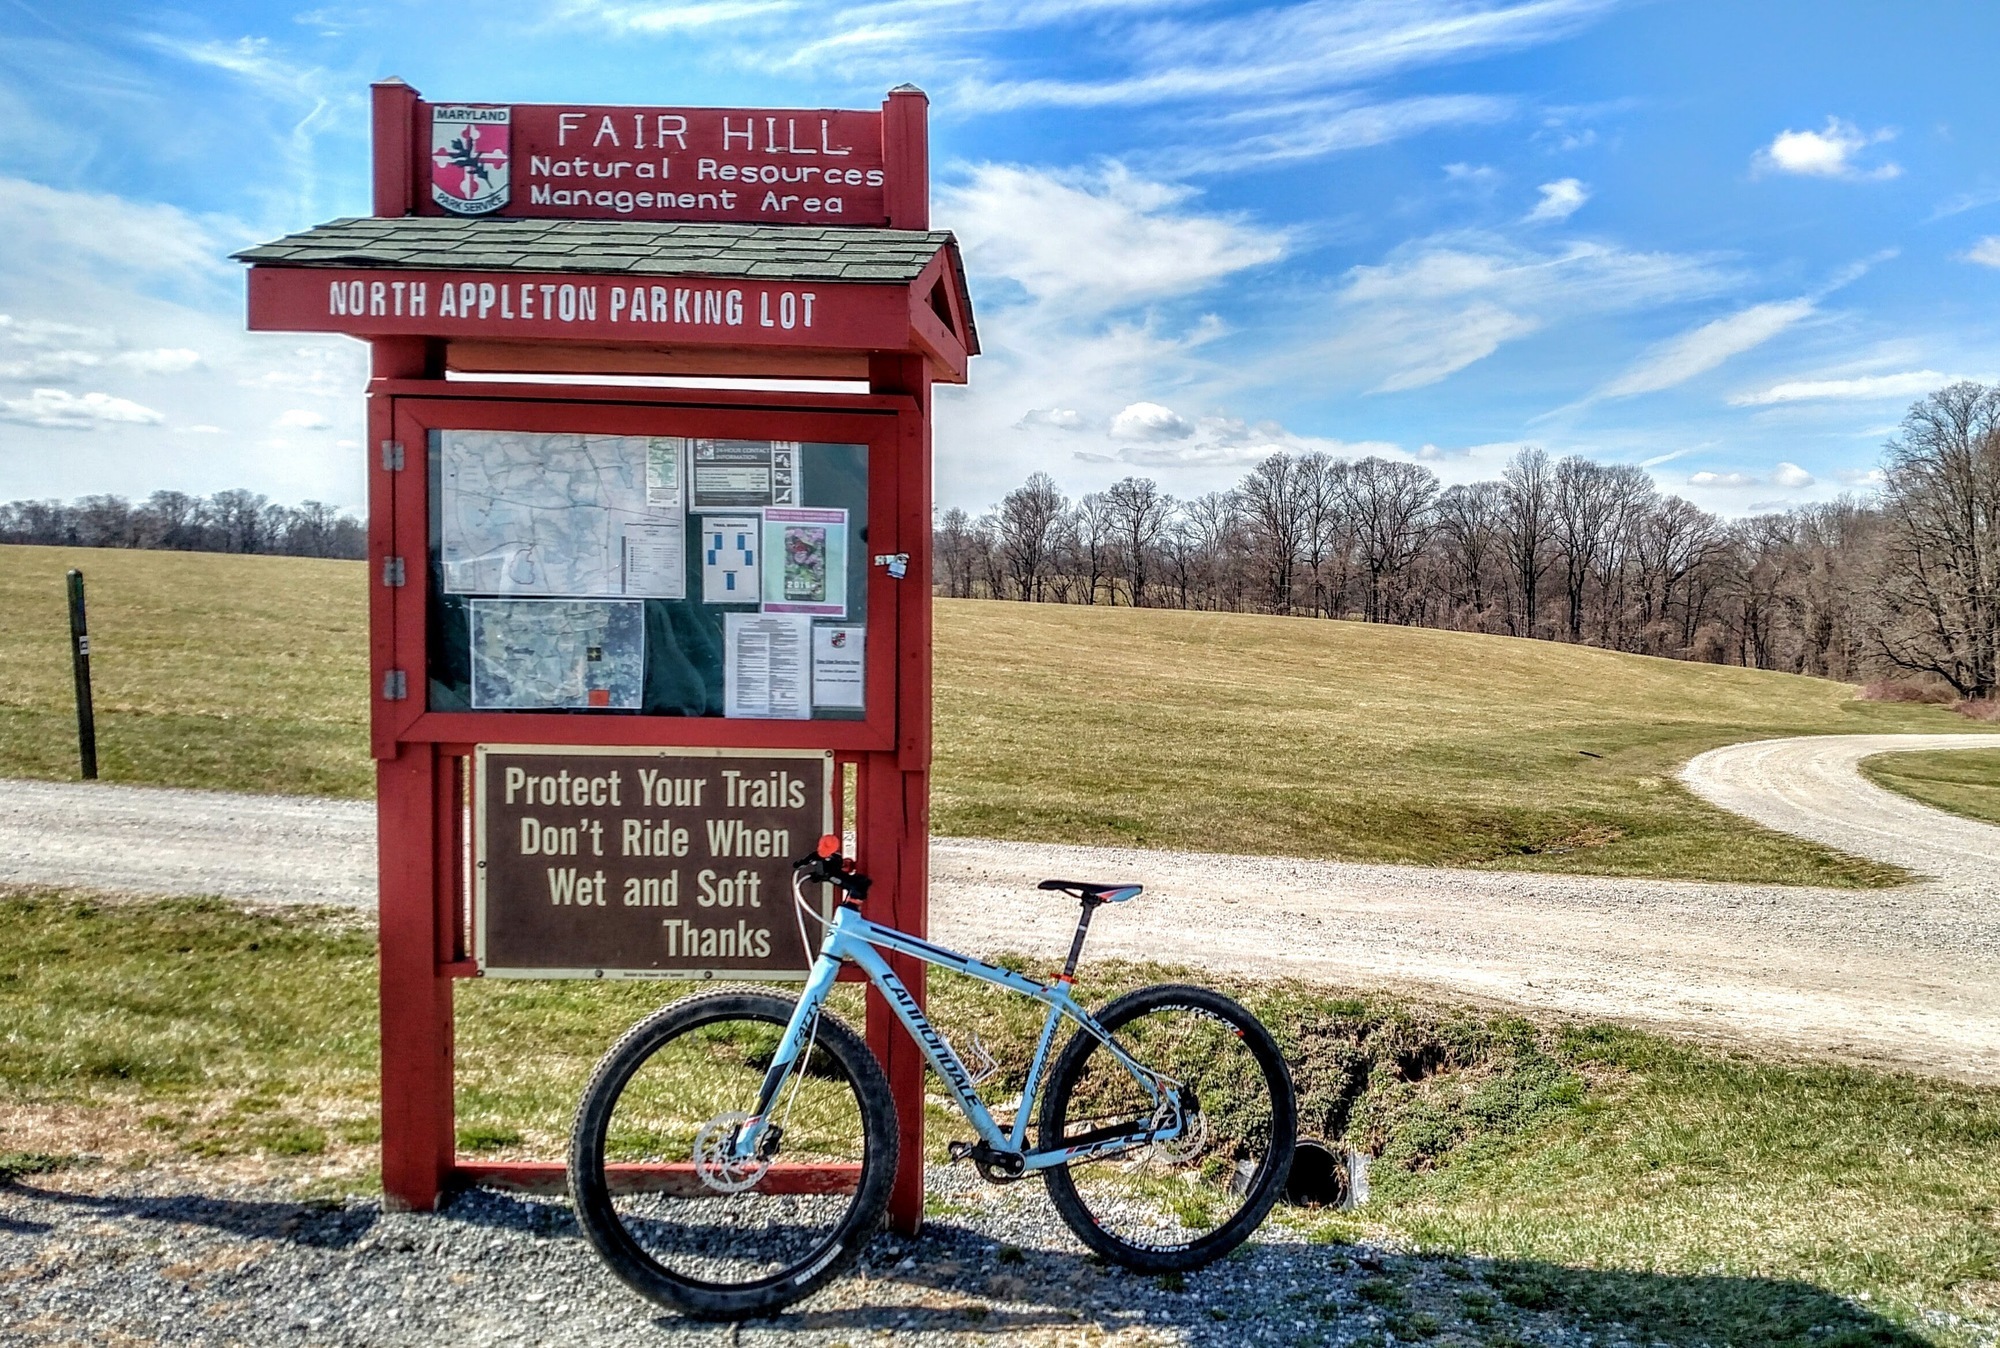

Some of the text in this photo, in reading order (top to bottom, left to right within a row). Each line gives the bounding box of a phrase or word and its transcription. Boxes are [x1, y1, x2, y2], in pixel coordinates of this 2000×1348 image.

[436, 109, 507, 122] MARYLAND
[558, 112, 851, 155] FAIR HILL
[530, 155, 884, 187] Natural Resources
[436, 192, 503, 213] PARK SERVICE
[530, 184, 842, 213] Management Area
[329, 280, 816, 330] NORTH APPLETON PARKING LOT
[505, 766, 806, 809] Protect Your Trails
[520, 817, 790, 859] Don't Ride When
[548, 867, 761, 908] Wet and Soft
[662, 919, 772, 958] Thanks
